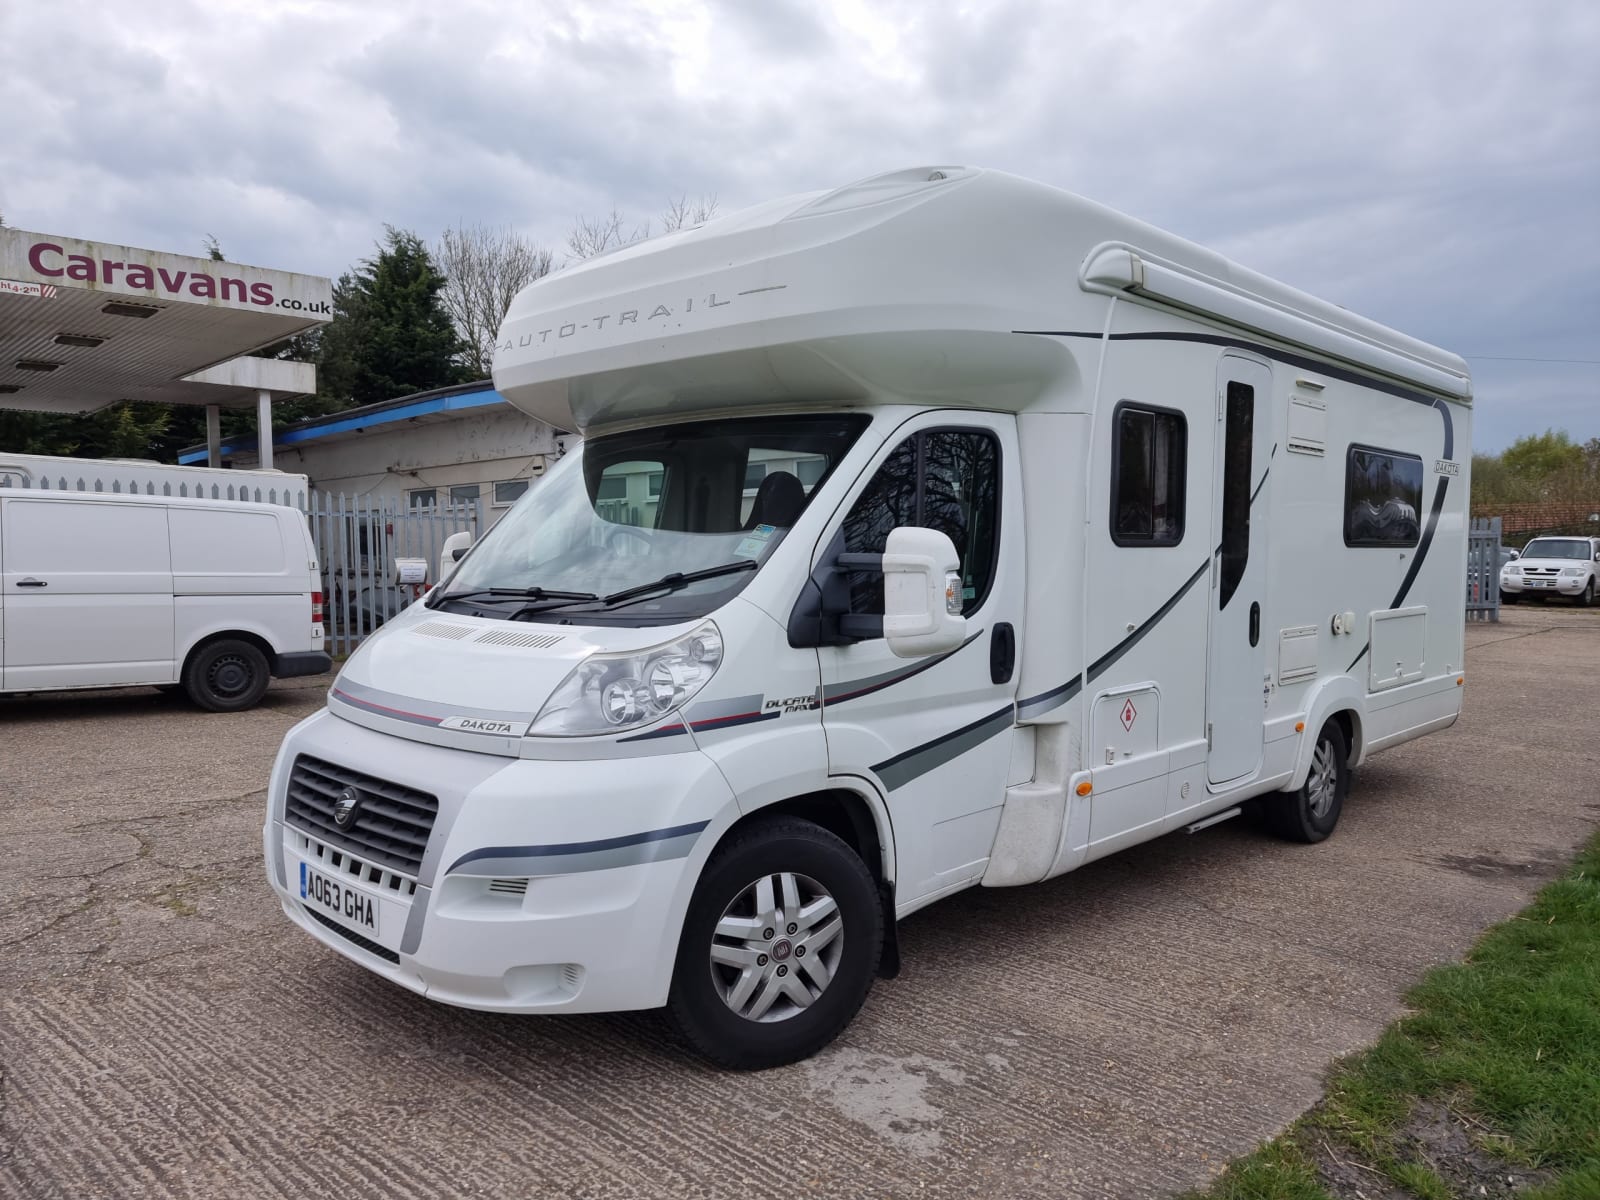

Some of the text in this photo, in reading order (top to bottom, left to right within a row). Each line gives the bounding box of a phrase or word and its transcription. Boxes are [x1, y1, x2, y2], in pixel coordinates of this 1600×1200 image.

[503, 293, 730, 351] AUTO-TRAIL
[785, 704, 812, 713] MAX
[460, 720, 512, 732] DAKOTA
[344, 889, 374, 929] GHA
